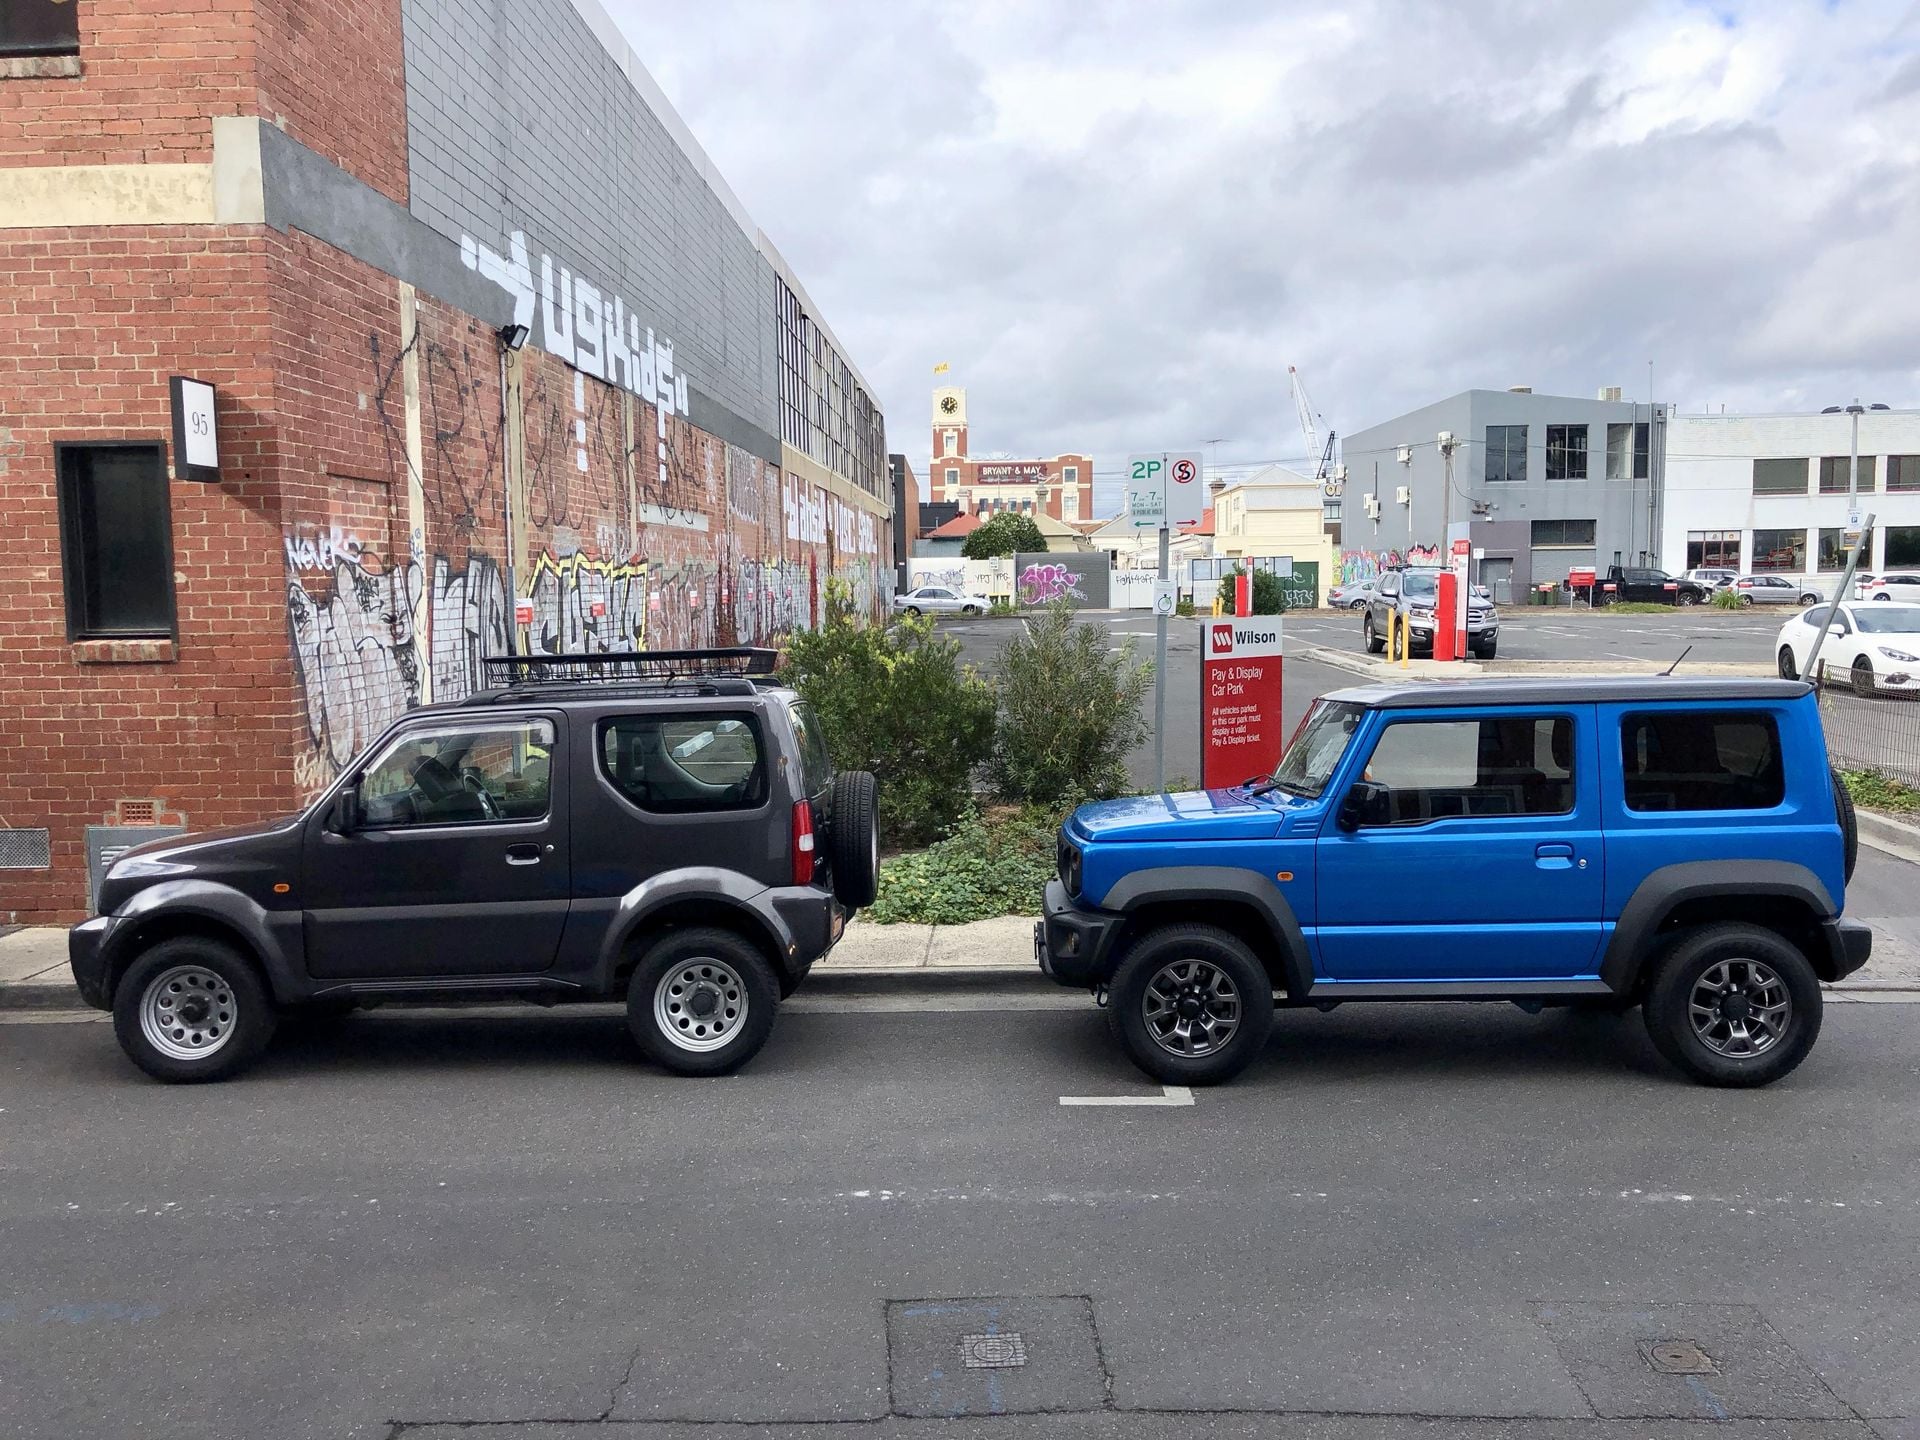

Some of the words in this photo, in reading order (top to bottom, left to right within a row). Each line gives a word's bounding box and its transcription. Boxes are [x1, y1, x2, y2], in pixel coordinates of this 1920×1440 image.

[192, 411, 208, 436] 95
[982, 466, 1011, 475] BRYANT
[1014, 466, 1021, 475] &
[1023, 466, 1041, 475] MAY
[1132, 461, 1161, 479] 2P
[1235, 631, 1276, 644] Wilson
[1211, 668, 1226, 683] Pay
[1228, 667, 1234, 680] &
[1236, 666, 1263, 680] Display
[1211, 684, 1225, 696] Car
[1227, 683, 1244, 695] Park
[1220, 705, 1240, 715] vehicles
[1240, 704, 1257, 714] parked
[1212, 718, 1217, 726] in
[1218, 716, 1227, 725] this
[1237, 715, 1248, 725] park
[1249, 714, 1261, 722] must
[1212, 727, 1229, 737] display
[1235, 725, 1247, 733] valid
[1212, 737, 1221, 746] Pay
[1223, 737, 1227, 745] &
[1228, 735, 1246, 745] Display
